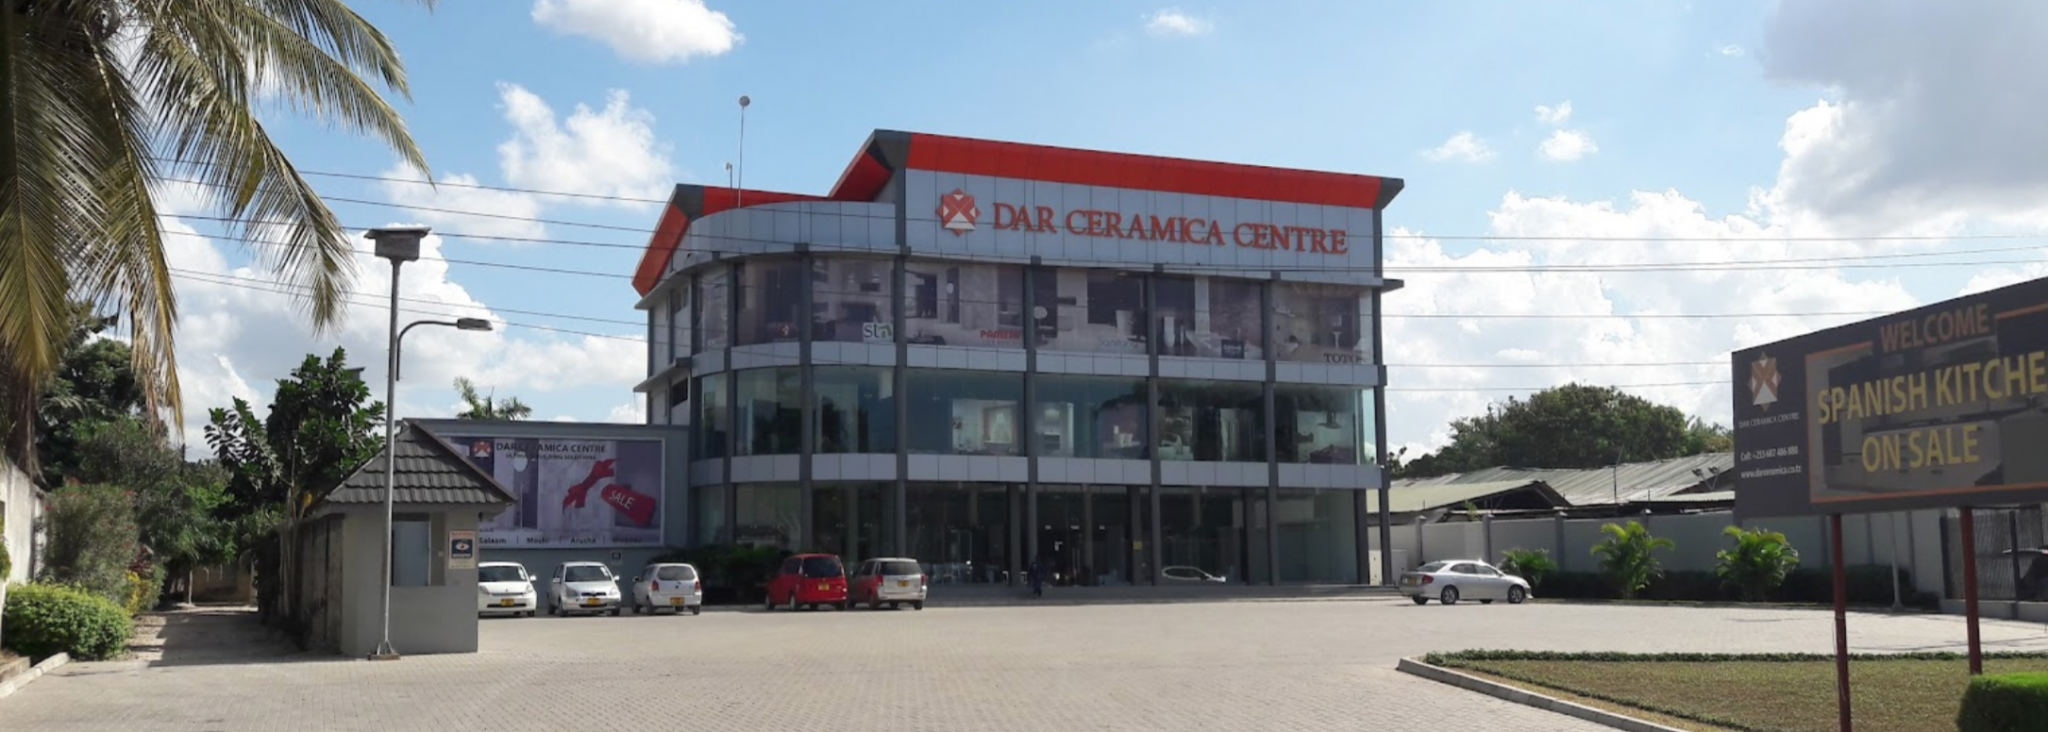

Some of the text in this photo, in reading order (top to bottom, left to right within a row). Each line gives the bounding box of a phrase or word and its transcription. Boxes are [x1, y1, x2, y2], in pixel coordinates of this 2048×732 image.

[992, 201, 1348, 255] DAR CERAMICA CENTRE
[1880, 303, 1989, 352] WELCOME
[1818, 351, 2048, 425] SPANISH KITCHE
[1738, 412, 1799, 429] DAR CERAMICA CENTRE
[496, 442, 606, 453] DAR CERAMICA CENTRE
[1862, 424, 1979, 472] ON SALE
[609, 490, 635, 510] SALE
[526, 536, 550, 544] Moshi
